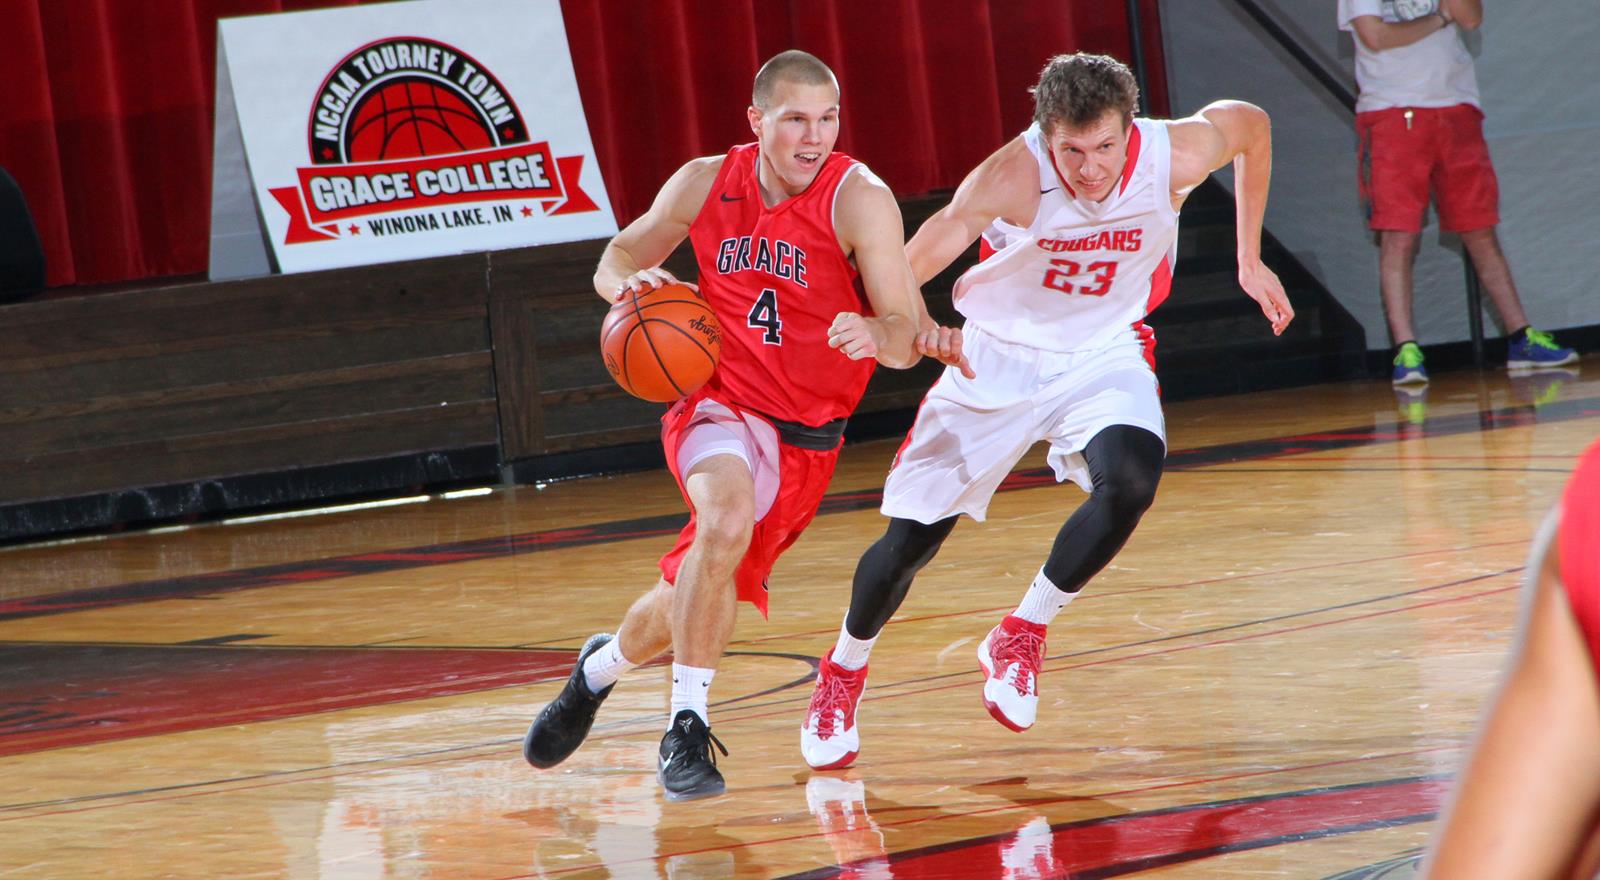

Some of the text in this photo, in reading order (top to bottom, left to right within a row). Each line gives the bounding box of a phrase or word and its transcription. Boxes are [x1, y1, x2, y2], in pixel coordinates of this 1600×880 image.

[314, 43, 515, 142] NCCAA TOURNEY TOWN
[309, 152, 551, 212] GRACE COLLEGE
[367, 205, 513, 237] WINONA LAKE, IN
[1036, 228, 1143, 253] COUGARS
[716, 235, 808, 288] GRACE
[1042, 258, 1118, 297] 23
[747, 288, 782, 346] 4
